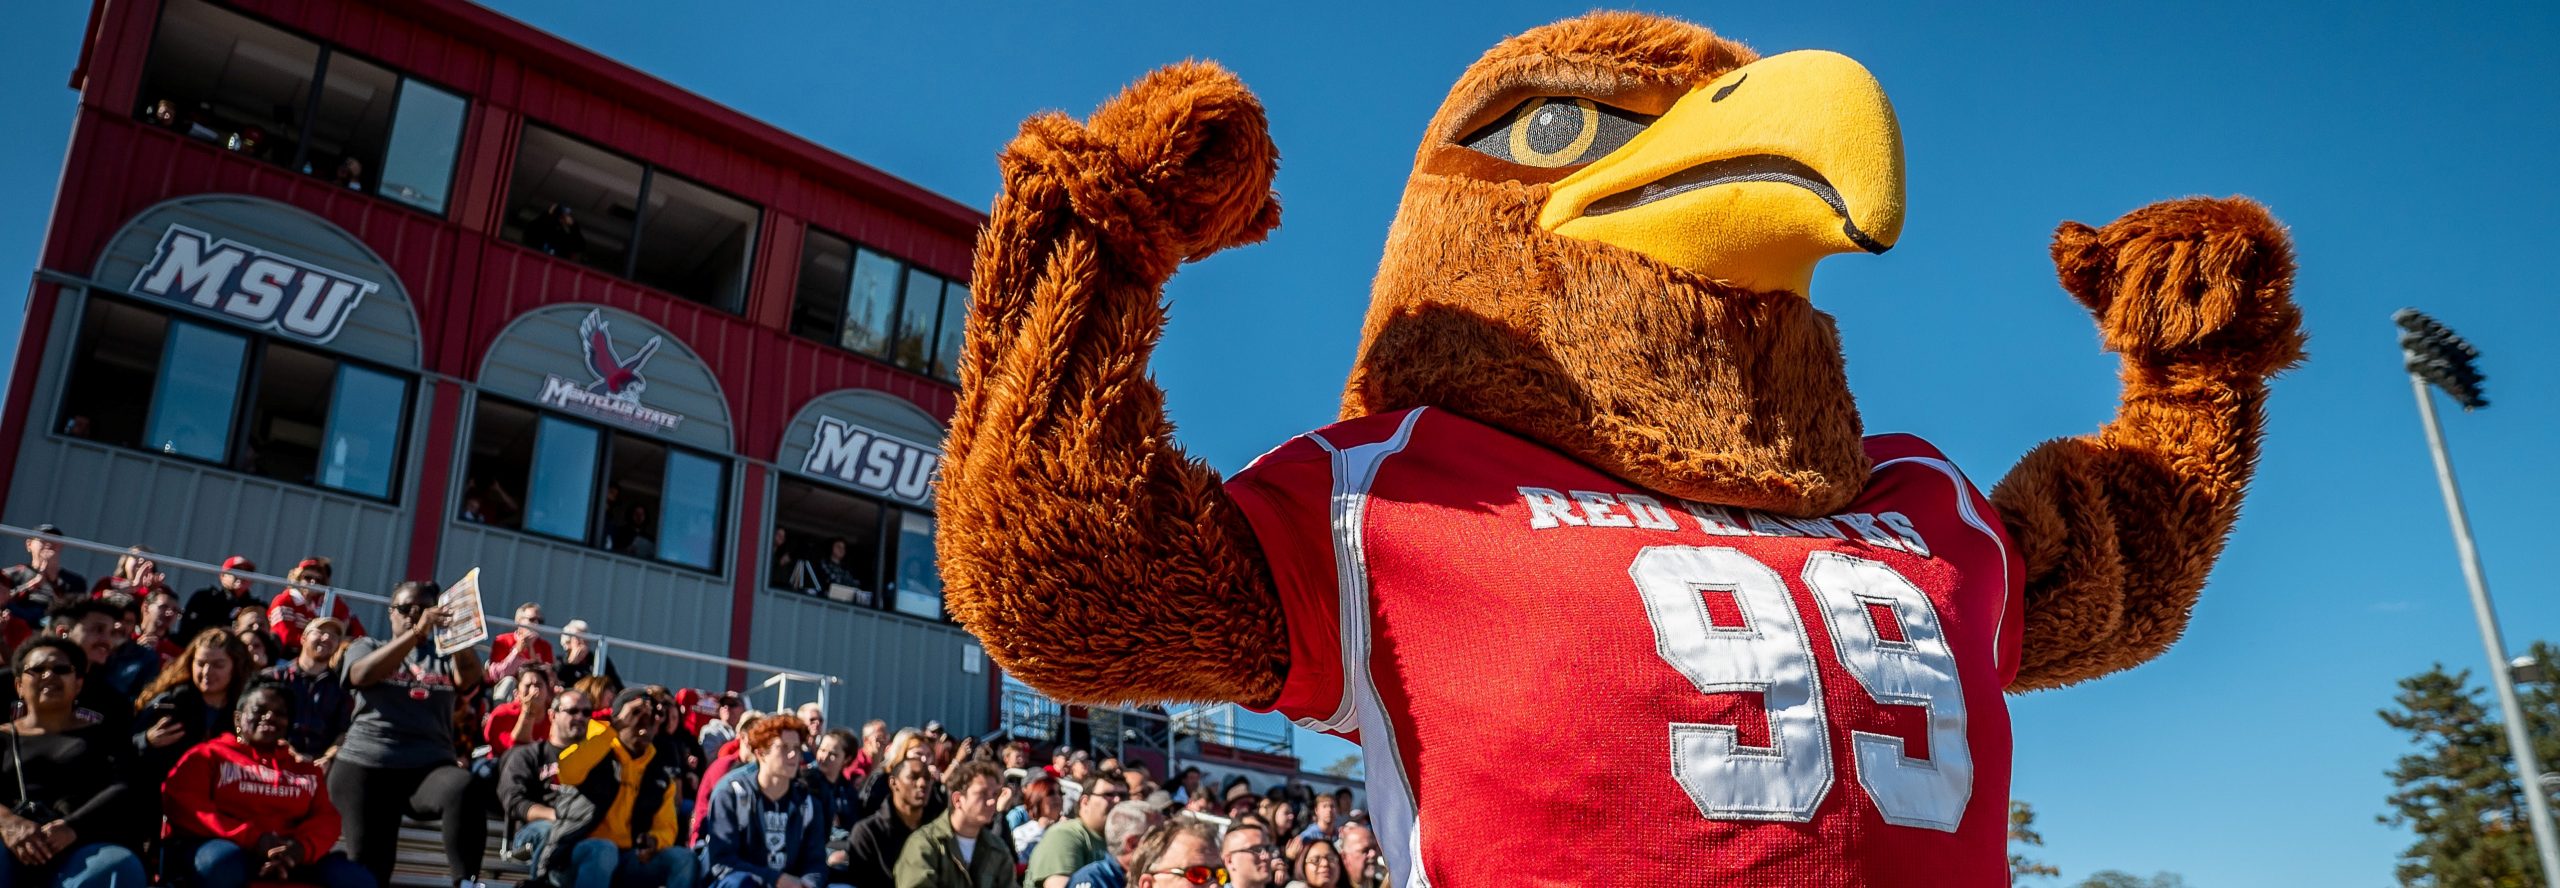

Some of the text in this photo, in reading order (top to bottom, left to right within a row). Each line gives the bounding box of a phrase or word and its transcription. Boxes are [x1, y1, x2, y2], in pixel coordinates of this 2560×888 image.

[138, 229, 363, 340] MSU
[634, 406, 678, 429] STATE
[807, 420, 938, 500] MSU
[1517, 486, 1930, 557] RED HAWKS
[1628, 545, 1974, 833] 99
[238, 782, 301, 797] UNIVERSITY
